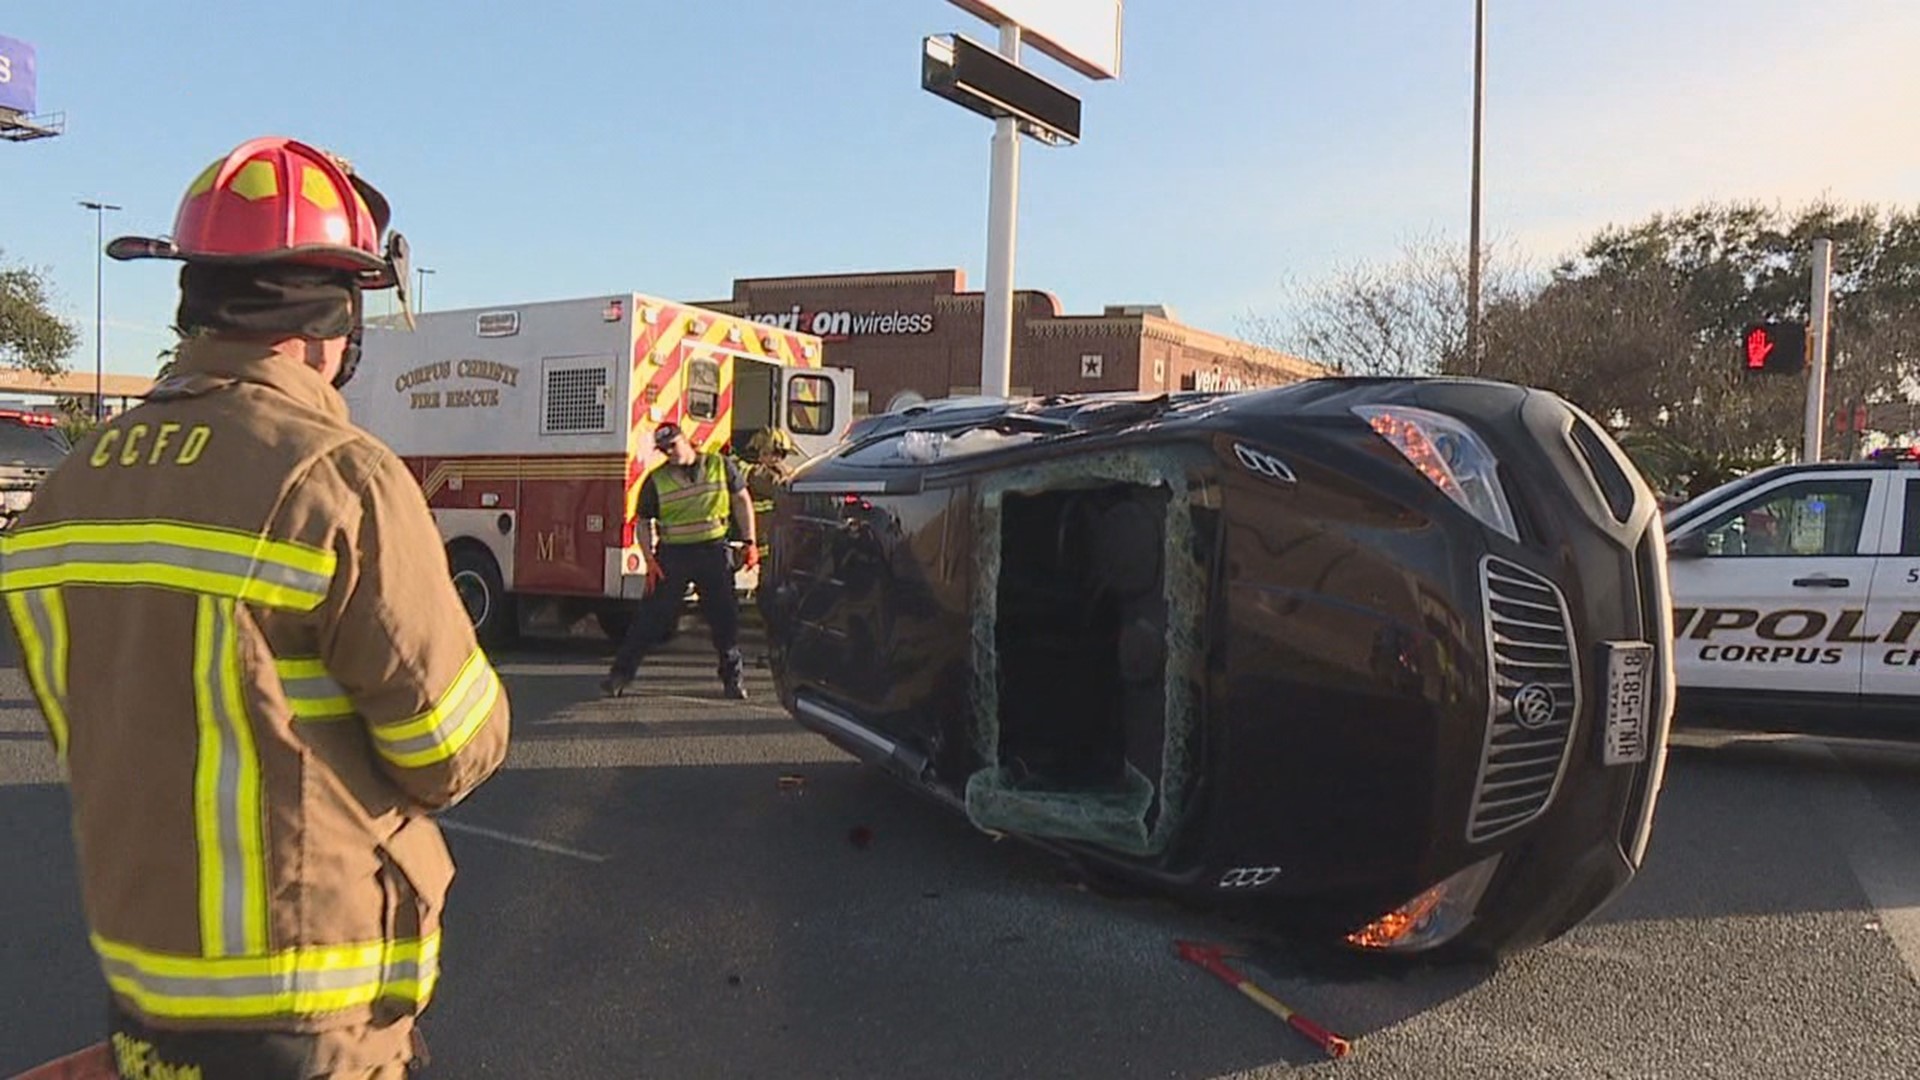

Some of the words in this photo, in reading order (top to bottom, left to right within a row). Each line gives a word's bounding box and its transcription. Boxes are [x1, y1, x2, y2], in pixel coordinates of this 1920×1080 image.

[852, 310, 933, 334] wireless
[395, 360, 451, 393] CORPUS
[457, 358, 521, 387] CHRISTI
[410, 391, 440, 410] FIRE
[445, 388, 499, 408] RESCUE
[90, 423, 212, 467] CCFD
[535, 531, 554, 562] M
[1690, 608, 1920, 644] POLI
[1699, 645, 1842, 664] CORPUS
